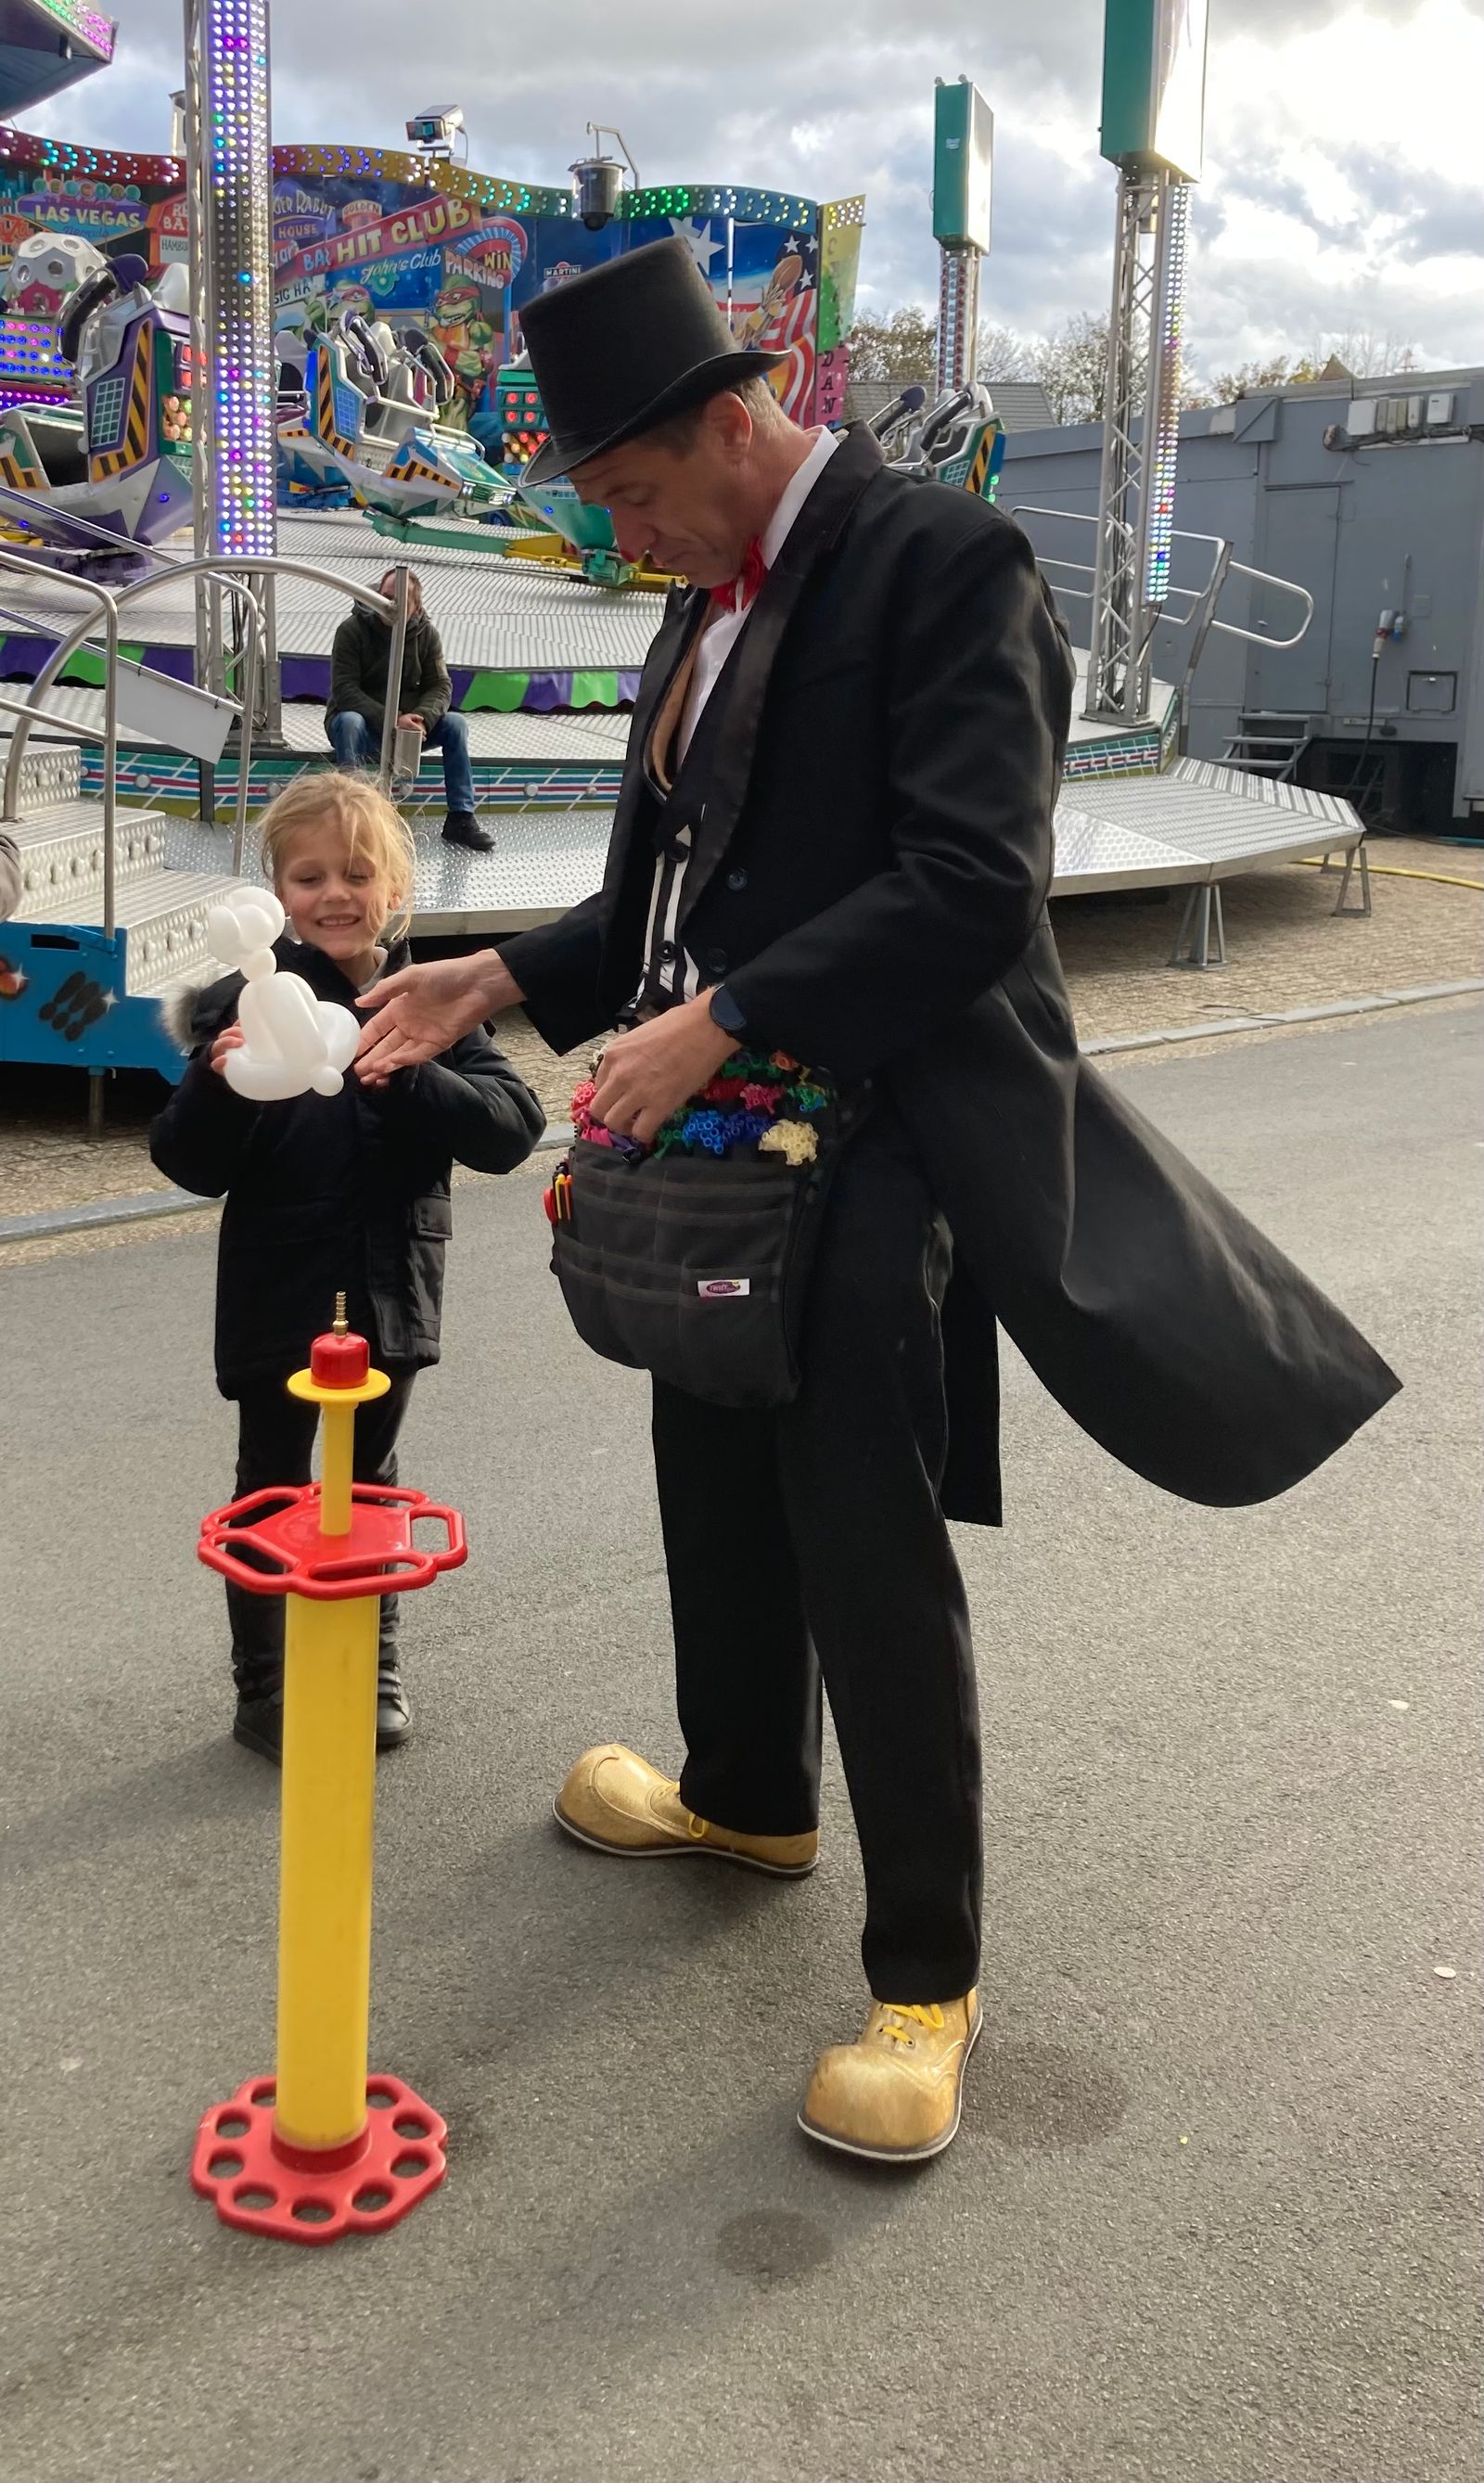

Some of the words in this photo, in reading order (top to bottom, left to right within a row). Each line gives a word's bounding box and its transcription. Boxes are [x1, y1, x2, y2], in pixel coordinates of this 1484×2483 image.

[35, 205, 70, 224] LAS
[76, 209, 141, 229] VEGAS
[343, 202, 380, 214] GOLDEN
[279, 224, 318, 239] HOUSE
[337, 228, 383, 263] HIT
[391, 198, 471, 245] CLUB
[360, 259, 408, 285] John's
[410, 249, 441, 270] Club
[445, 250, 505, 289] PARKING
[545, 266, 582, 276] MARTINI
[820, 350, 838, 425] DAN
